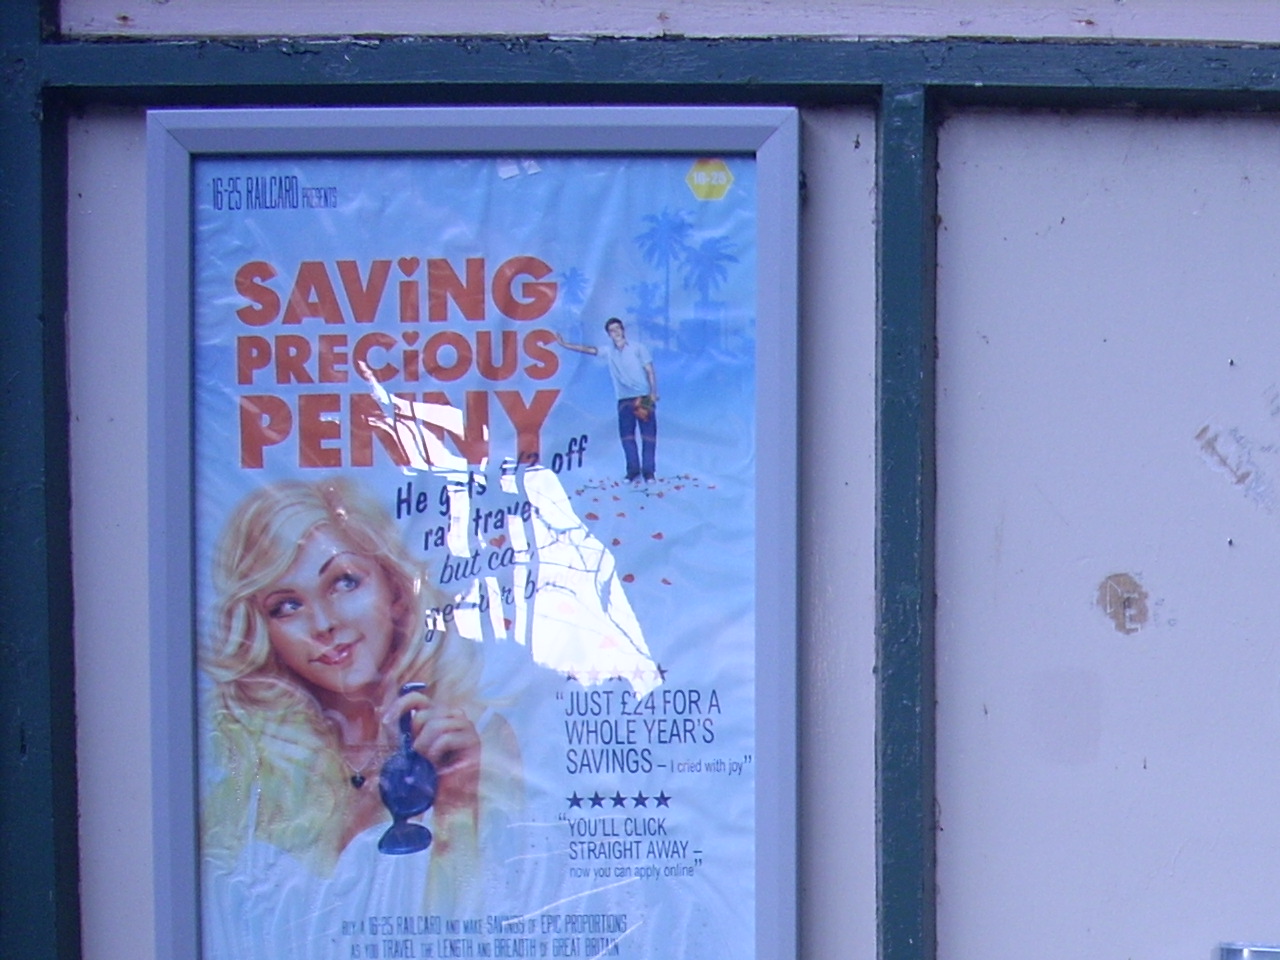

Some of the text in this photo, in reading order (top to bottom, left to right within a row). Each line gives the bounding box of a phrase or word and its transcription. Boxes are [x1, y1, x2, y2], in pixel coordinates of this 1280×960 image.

[212, 175, 337, 210] 16-25 RAILCARD PRESENTS
[239, 388, 561, 469] PENNY
[396, 482, 427, 519] He
[439, 471, 487, 516] gts
[552, 434, 588, 474] off
[473, 494, 539, 536] trave
[440, 549, 481, 584] but
[621, 690, 656, 715] £24
[663, 689, 702, 715] FOR
[707, 689, 721, 714] A
[565, 718, 715, 745] WHOLE YEAR'S
[566, 748, 653, 774] SAVINGS
[677, 759, 701, 773] cried
[705, 760, 726, 773] with
[624, 818, 667, 836] CLICK
[569, 841, 642, 860] STRAIGHT
[646, 841, 689, 859] AWAY
[570, 866, 591, 878] now
[594, 866, 611, 880] you
[614, 866, 631, 878] can
[634, 865, 660, 880] apply
[397, 916, 440, 935] RAILCARD
[487, 915, 524, 934] SAVINGS
[541, 915, 561, 934] EPIC
[565, 914, 627, 934] PROPORTIONS
[382, 939, 416, 958] TRAVEL
[438, 939, 473, 958] LENGTH
[495, 938, 536, 957] BREADTH
[553, 938, 580, 957] GREAT
[585, 938, 619, 957] BRITAIN
